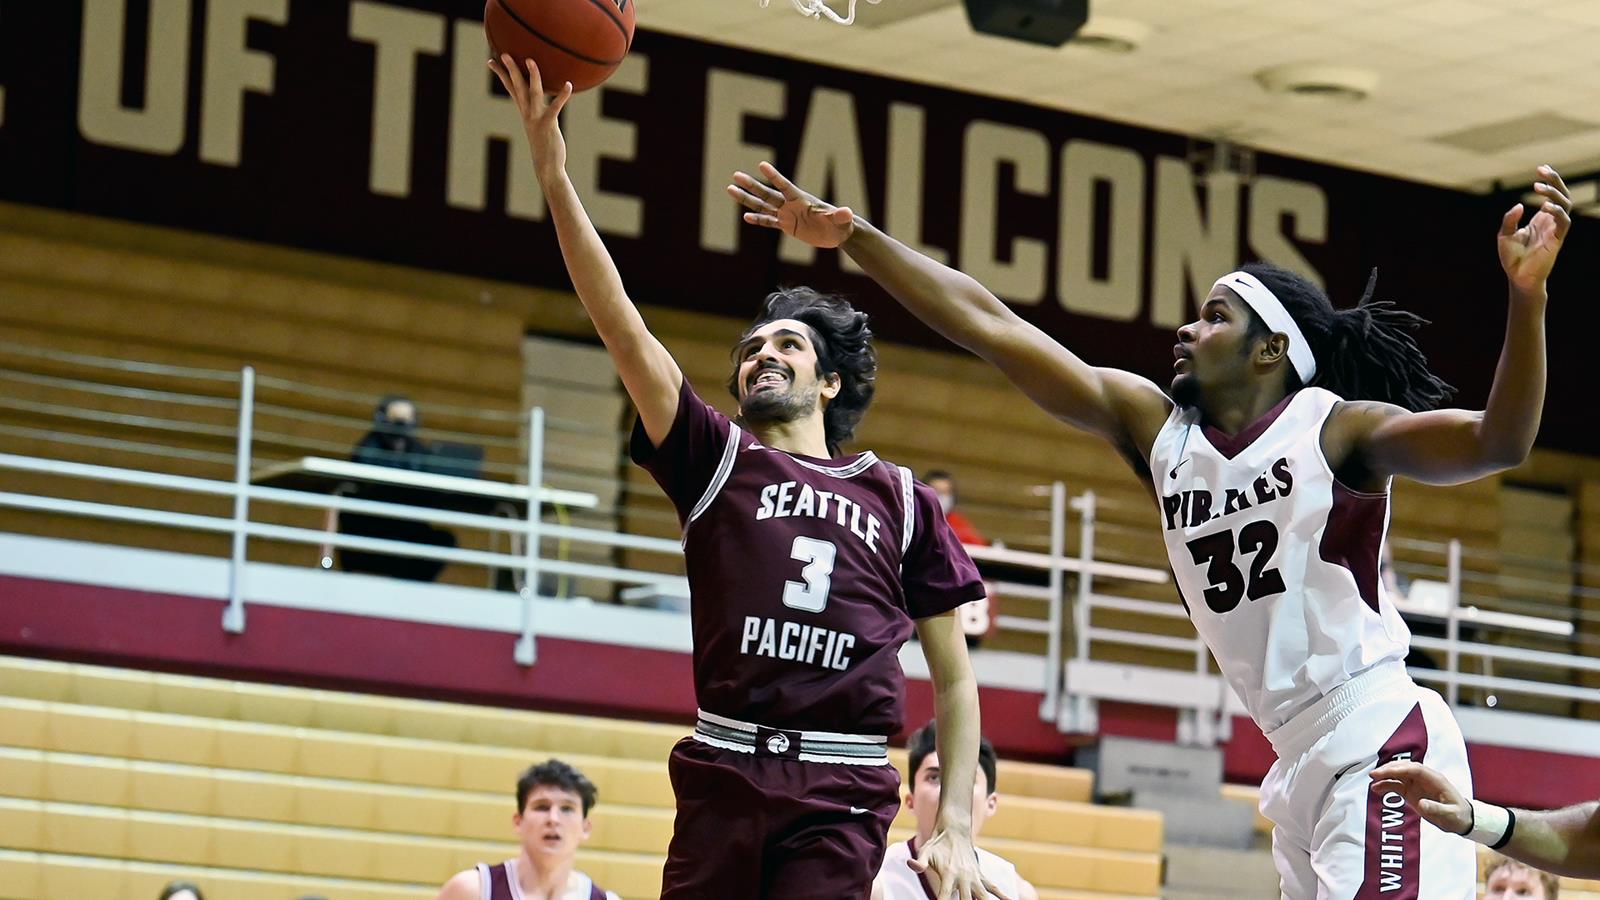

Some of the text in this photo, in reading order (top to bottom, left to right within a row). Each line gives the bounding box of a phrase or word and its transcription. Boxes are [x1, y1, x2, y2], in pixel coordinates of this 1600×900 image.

[77, 0, 1328, 329] OF THE FALCONS
[756, 481, 881, 554] SEATTLE
[782, 535, 837, 614] 3
[1185, 519, 1287, 614] 32
[740, 616, 856, 671] PACIFIC
[1380, 751, 1412, 893] WHITWO
